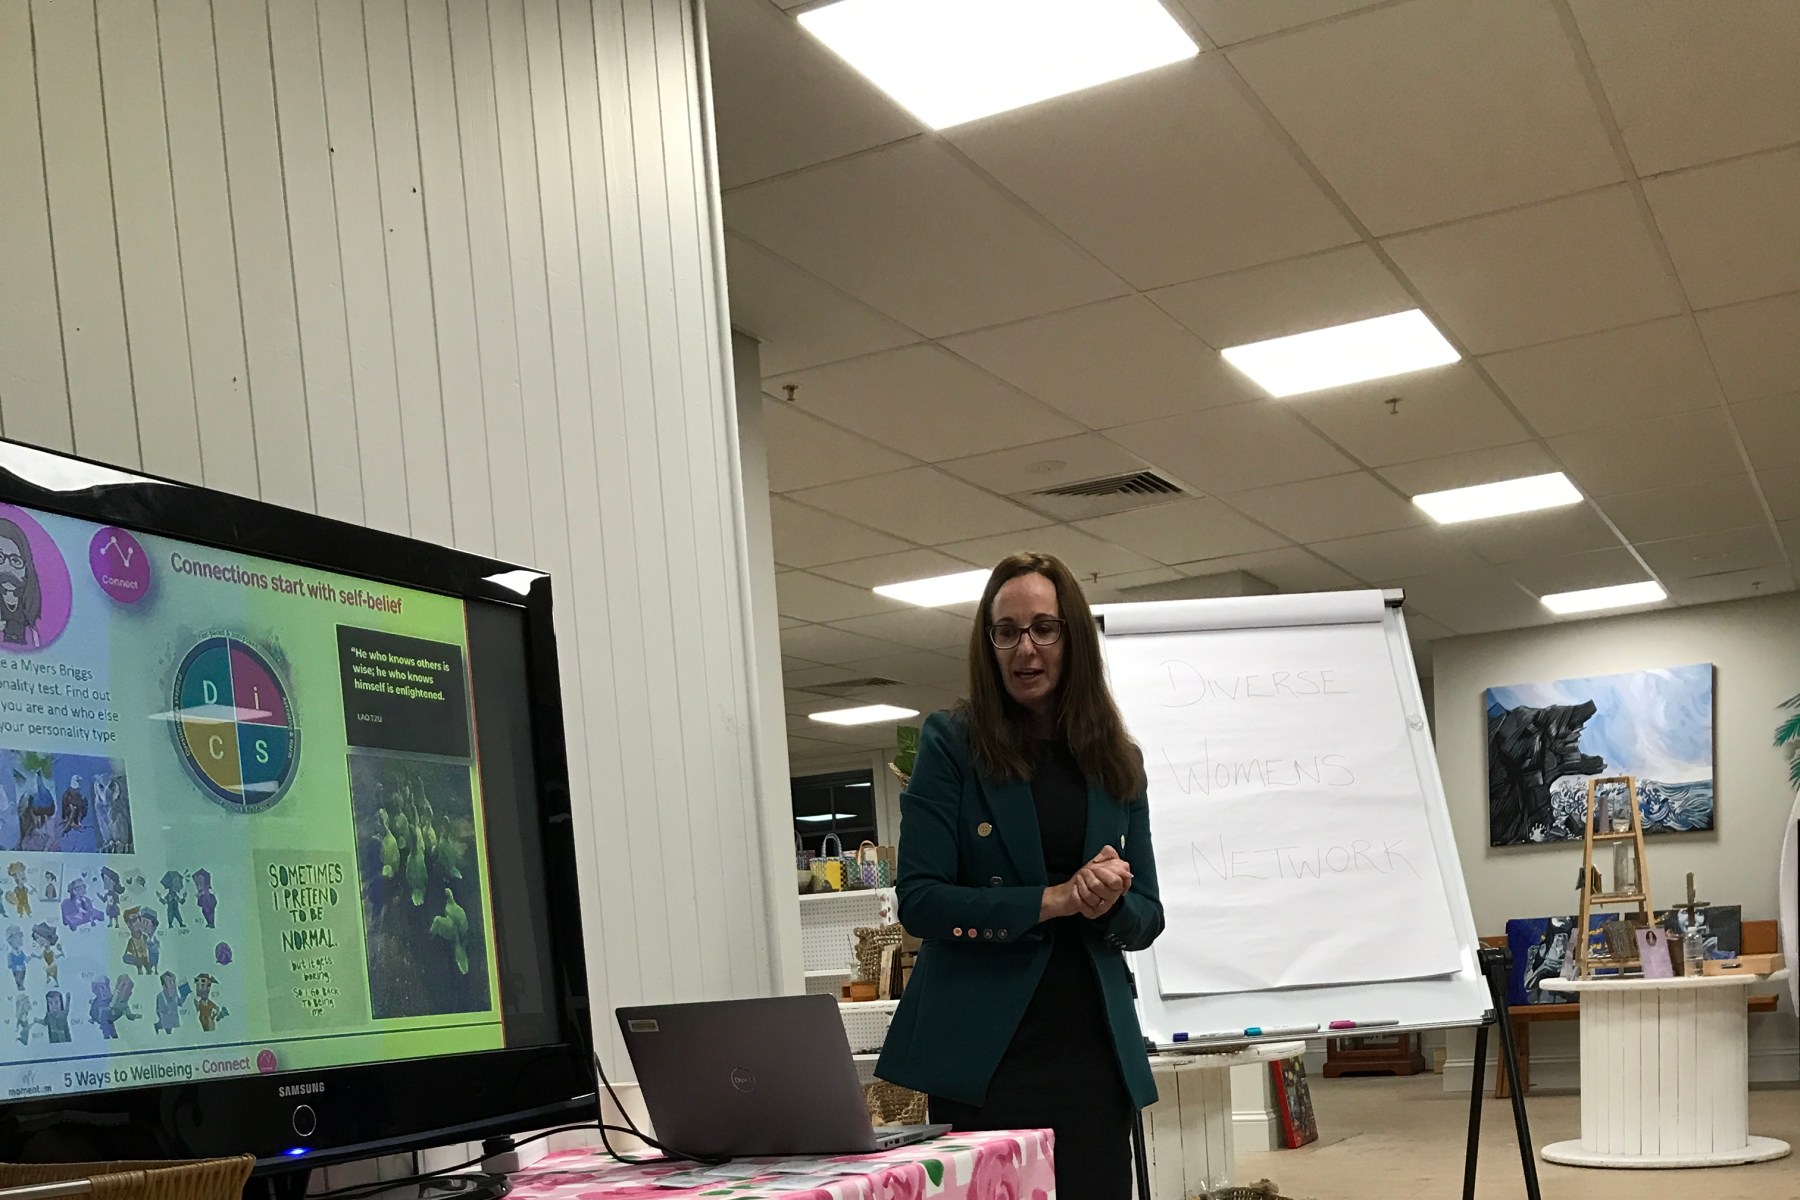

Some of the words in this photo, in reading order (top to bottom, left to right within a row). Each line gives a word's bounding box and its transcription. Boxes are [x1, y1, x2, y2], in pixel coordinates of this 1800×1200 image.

[102, 574, 138, 589] Connect
[171, 552, 268, 589] Connections
[271, 574, 306, 597] start
[307, 581, 336, 602] with
[339, 589, 403, 615] self-belief
[11, 660, 18, 670] a
[21, 658, 57, 675] Myers
[59, 663, 93, 682] Briggs
[352, 663, 375, 677] wise;
[376, 666, 387, 677] he
[388, 669, 406, 680] who
[407, 671, 434, 684] knows
[369, 651, 387, 662] who
[388, 653, 415, 667] knows
[416, 659, 442, 671] others
[442, 661, 450, 672] is
[66, 684, 89, 699] Find
[92, 690, 111, 702] out
[203, 680, 218, 705] D
[253, 686, 260, 710] i
[354, 679, 386, 693] himself
[387, 683, 395, 694] is
[395, 685, 445, 701] enlightened.
[1160, 659, 1349, 708] DIVERSE
[1, 700, 22, 713] you
[26, 703, 44, 714] are
[47, 705, 68, 716] and
[70, 706, 95, 720] who
[98, 708, 119, 722] else
[28, 724, 90, 741] personality
[92, 727, 116, 743] type
[209, 735, 224, 760] C
[255, 740, 269, 764] S
[1161, 737, 1355, 795] WOMENS
[1191, 835, 1422, 886] NETWORK
[269, 862, 343, 888] SOMETIMES
[273, 891, 279, 911] I
[284, 887, 338, 909] PRETEND
[289, 909, 307, 923] TO
[310, 906, 323, 921] BE
[282, 928, 338, 952] NORMAL.
[291, 958, 306, 971] but
[308, 958, 315, 969] it
[316, 955, 332, 971] gets
[64, 1072, 73, 1088] 5
[74, 1070, 112, 1088] Ways
[113, 1070, 128, 1083] to
[130, 1063, 193, 1081] Wellbeing
[202, 1056, 251, 1074] Connect
[278, 1082, 325, 1097] SAMSUNG
